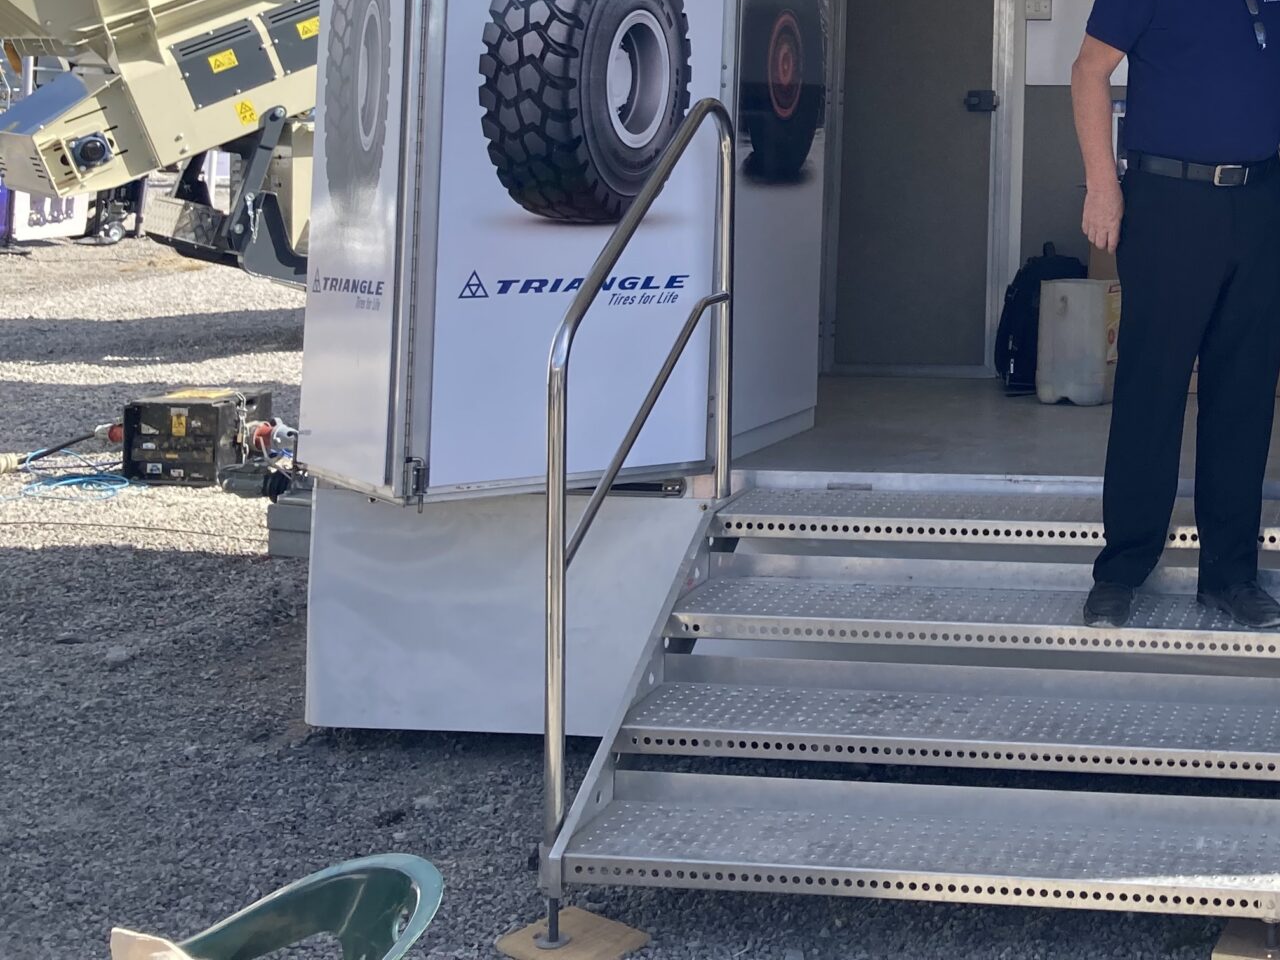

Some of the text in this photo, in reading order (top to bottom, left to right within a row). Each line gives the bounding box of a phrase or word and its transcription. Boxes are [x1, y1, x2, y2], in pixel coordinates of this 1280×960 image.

[323, 276, 385, 296] TRIANGLE
[608, 291, 679, 306] Tires for Life
